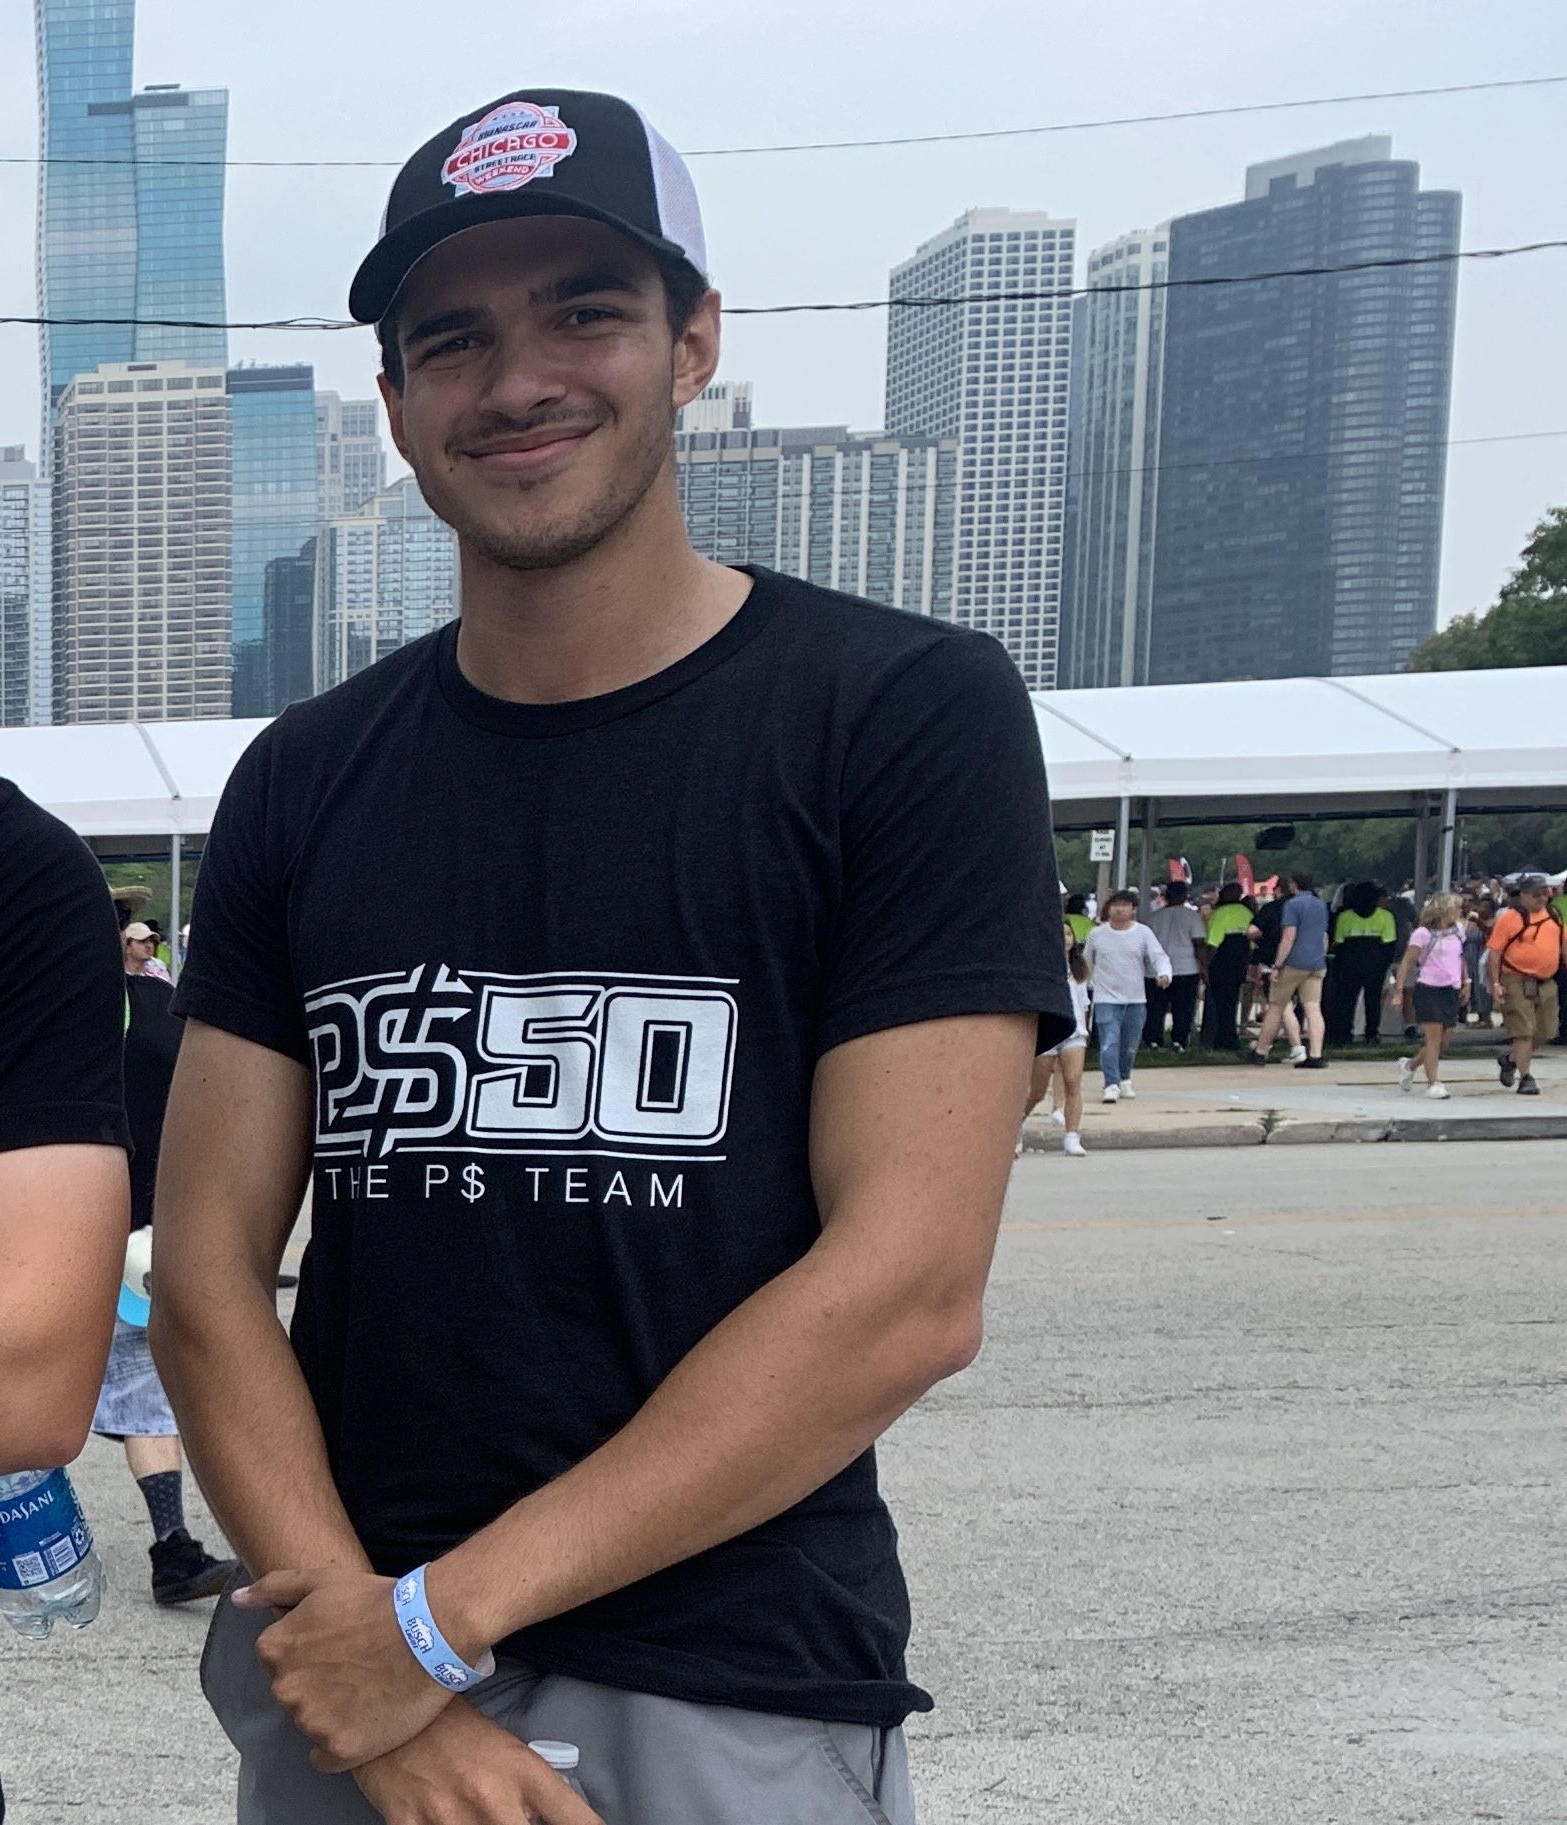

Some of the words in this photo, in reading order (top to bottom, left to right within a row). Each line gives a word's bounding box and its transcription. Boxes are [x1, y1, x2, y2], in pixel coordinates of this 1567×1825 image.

[456, 133, 559, 168] CHICAGO
[475, 165, 530, 184] WEEKEND
[325, 1165, 389, 1200] THE
[425, 1162, 486, 1203] P$
[525, 1166, 684, 1208] TEAM
[406, 1617, 433, 1654] BUSCH
[434, 1663, 463, 1686] BUSCH
